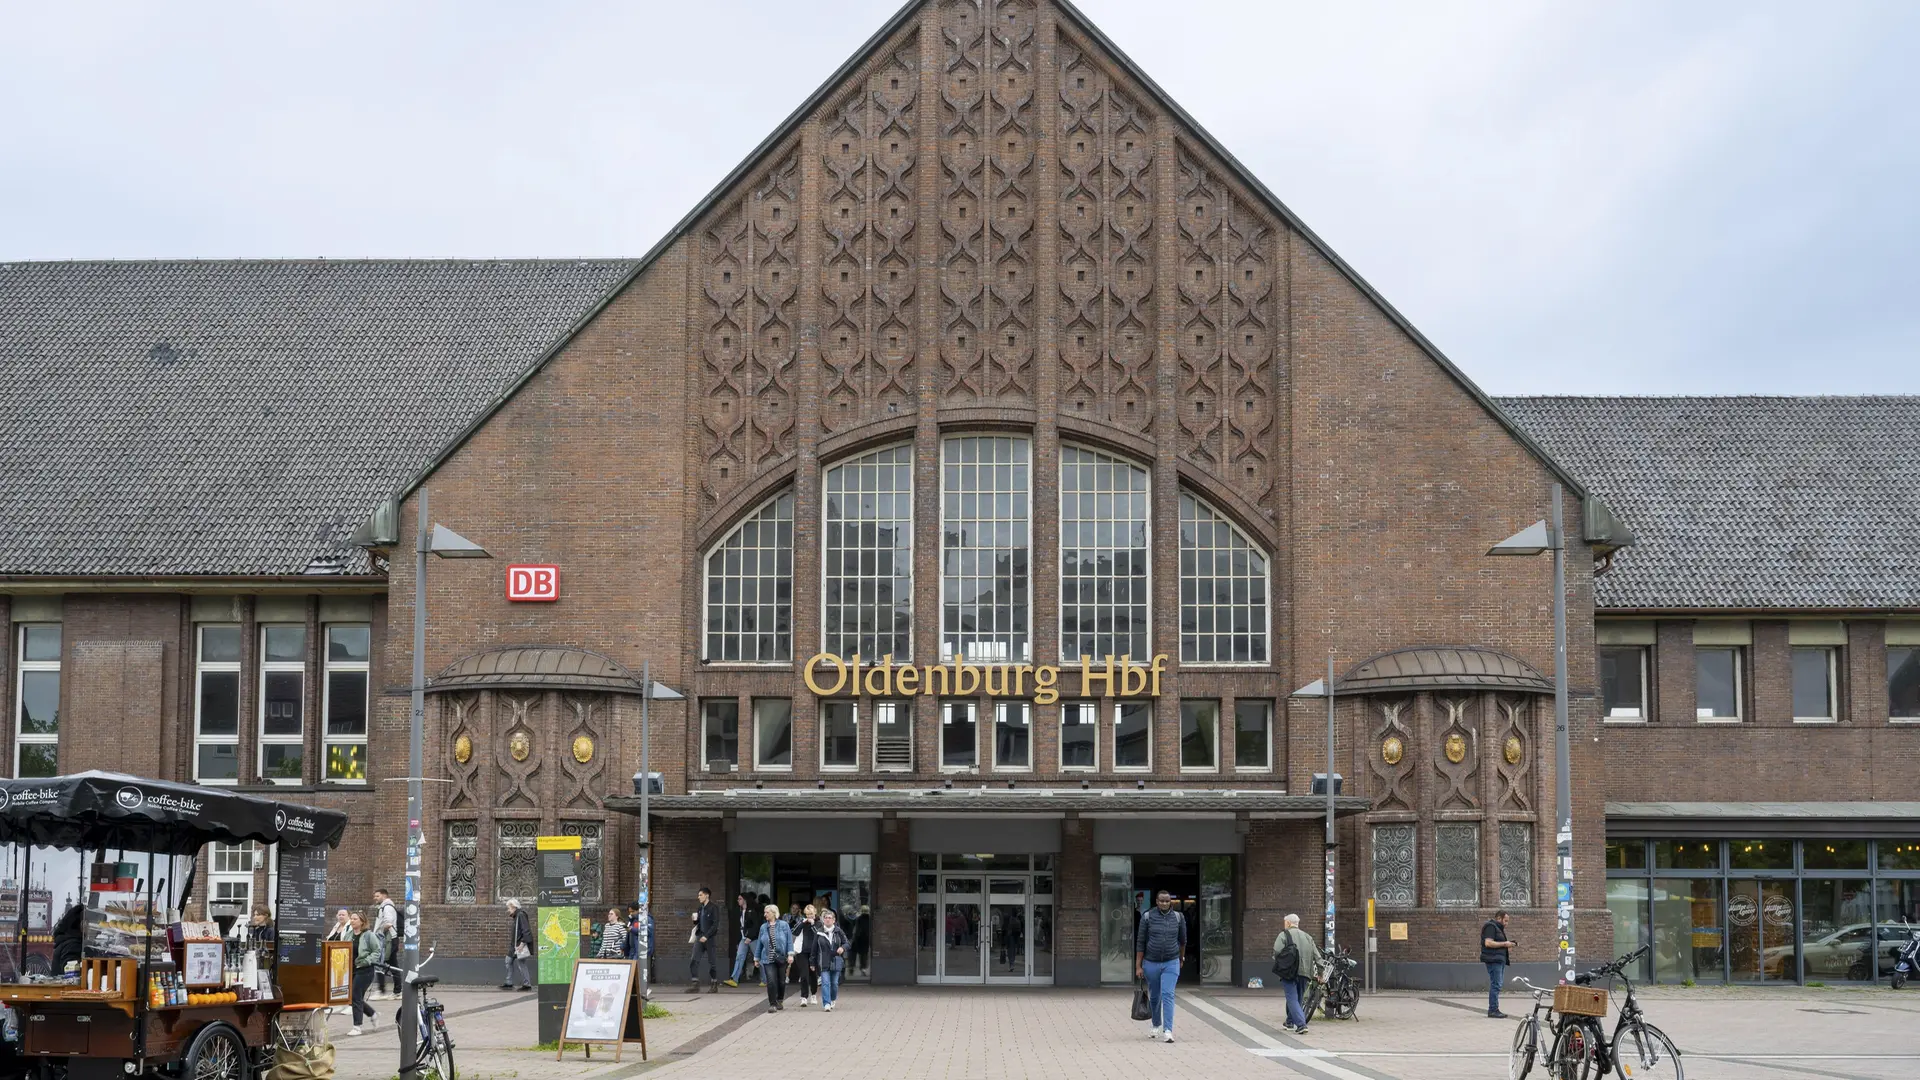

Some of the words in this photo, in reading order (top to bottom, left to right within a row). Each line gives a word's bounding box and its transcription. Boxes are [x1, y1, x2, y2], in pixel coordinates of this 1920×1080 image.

[513, 569, 553, 598] DB
[803, 652, 1060, 704] Oldenburg
[1081, 653, 1169, 697] Hbf
[12, 788, 59, 801] coffee-bike
[147, 794, 203, 811] coffee-bike
